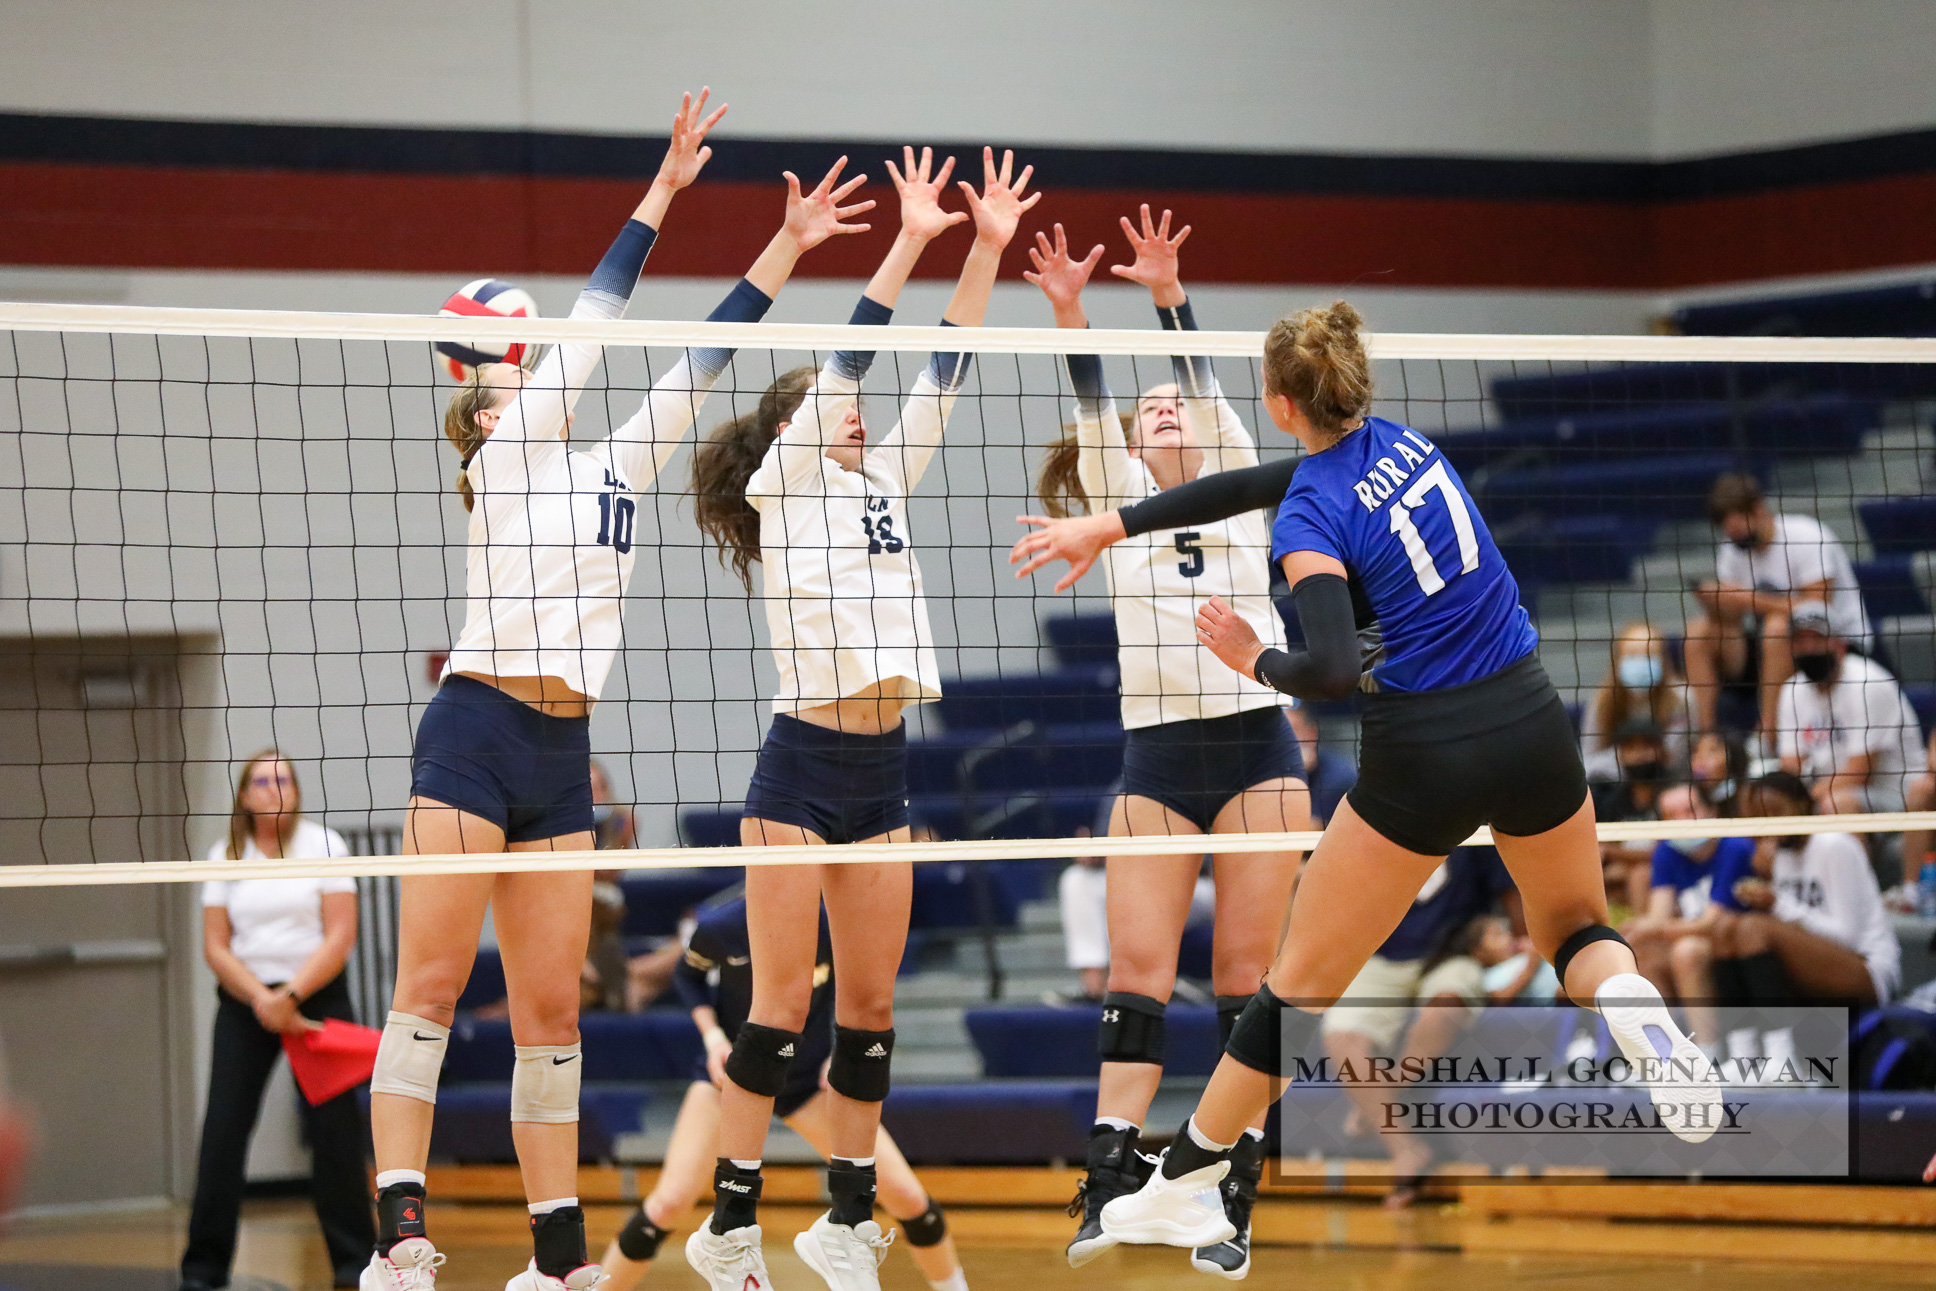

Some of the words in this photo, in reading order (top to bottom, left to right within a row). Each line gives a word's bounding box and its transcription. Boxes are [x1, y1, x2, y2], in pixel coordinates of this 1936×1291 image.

[1352, 429, 1436, 514] RURAL
[597, 493, 635, 554] 10
[1174, 532, 1205, 578] 5
[1388, 457, 1480, 597] 17
